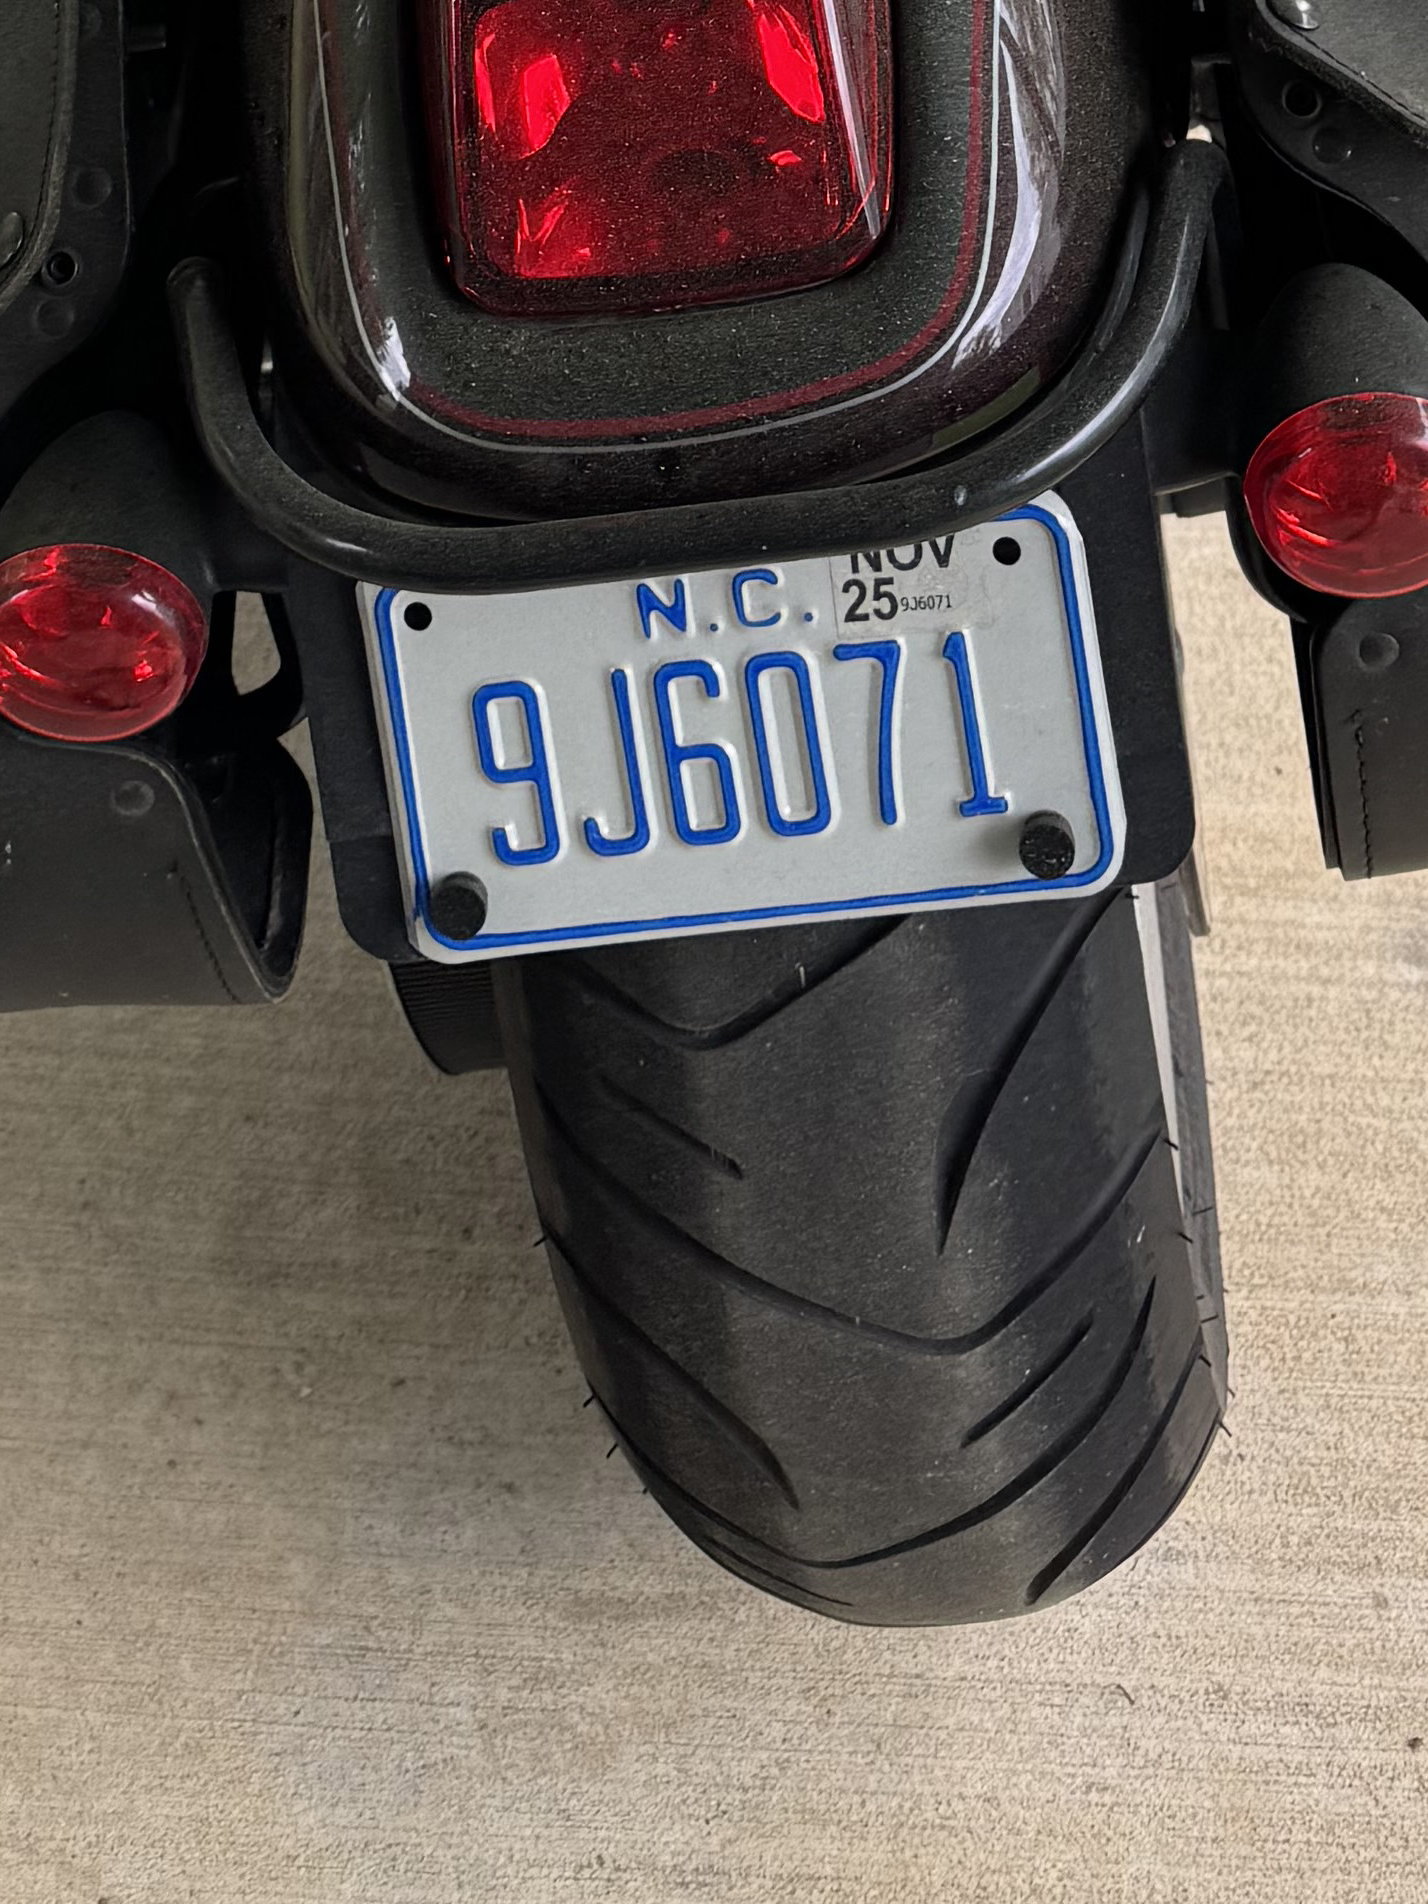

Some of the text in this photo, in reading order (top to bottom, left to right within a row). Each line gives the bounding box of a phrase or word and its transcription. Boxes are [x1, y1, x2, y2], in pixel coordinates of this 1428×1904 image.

[636, 568, 815, 639] N.C.
[841, 576, 953, 623] 25 9J6071
[471, 632, 1008, 867] 9J6071
